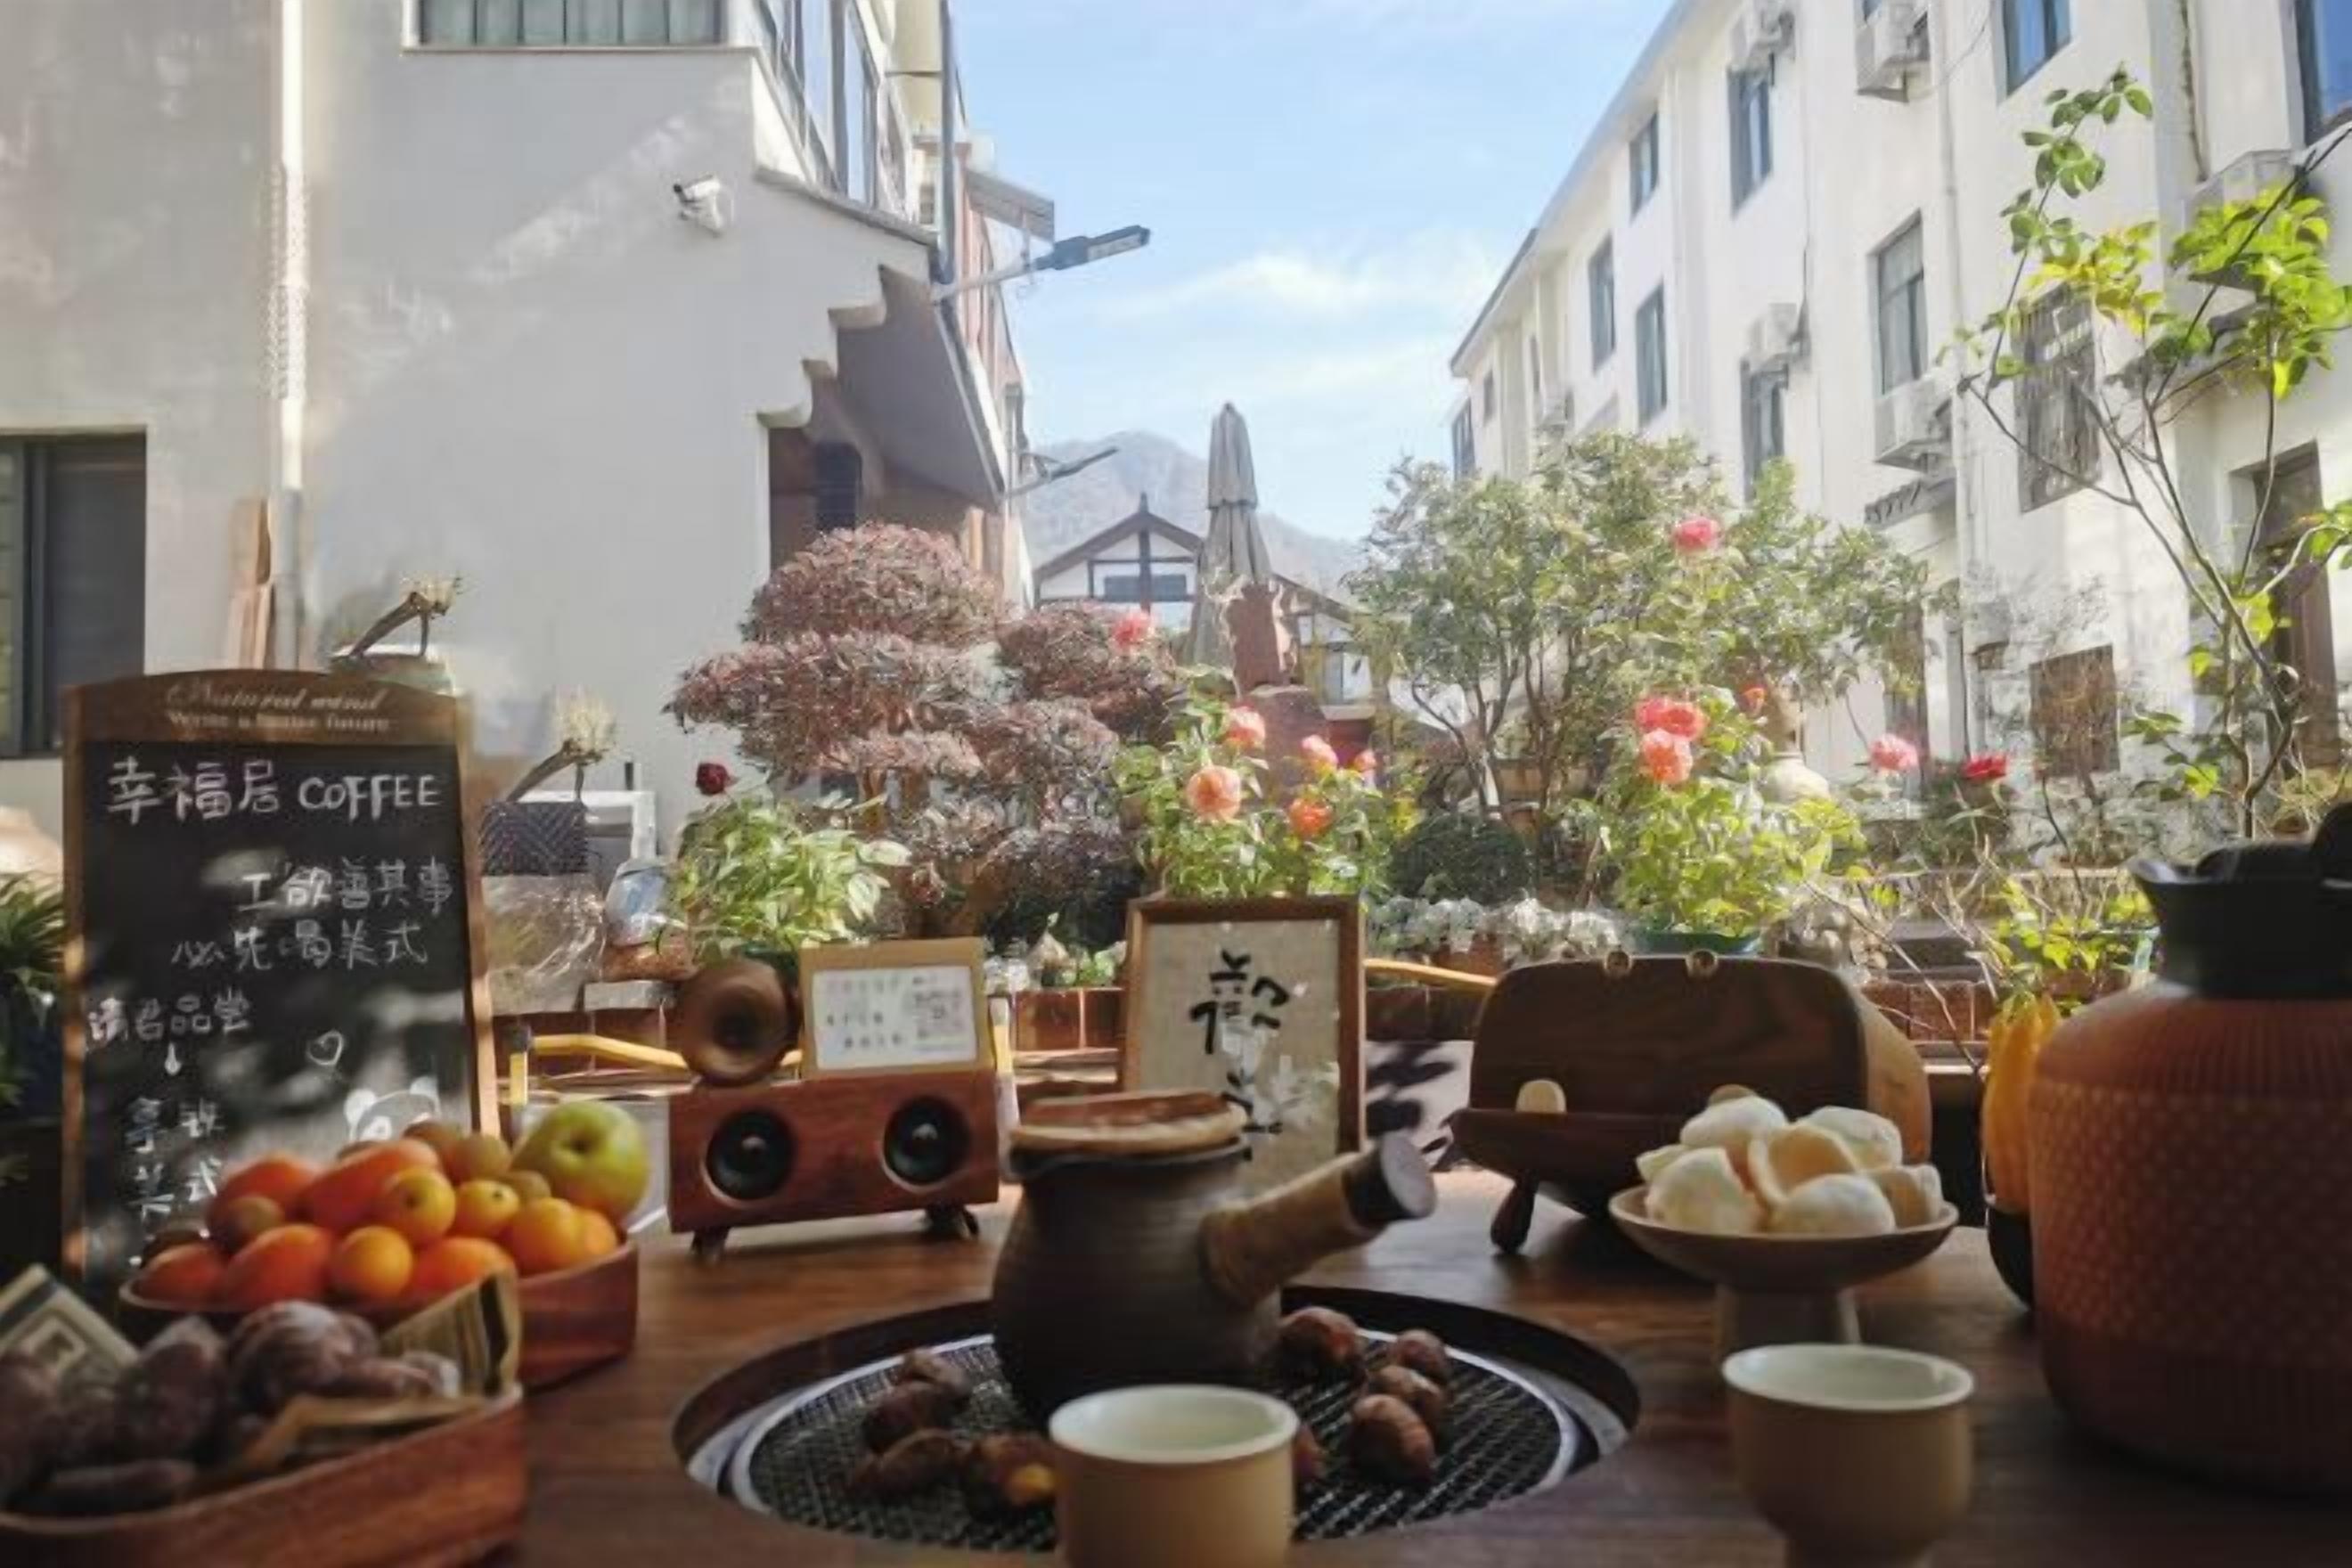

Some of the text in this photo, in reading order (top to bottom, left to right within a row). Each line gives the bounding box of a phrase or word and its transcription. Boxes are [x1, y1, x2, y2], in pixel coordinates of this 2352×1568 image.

[108, 755, 444, 825] 幸福居 COFFEE
